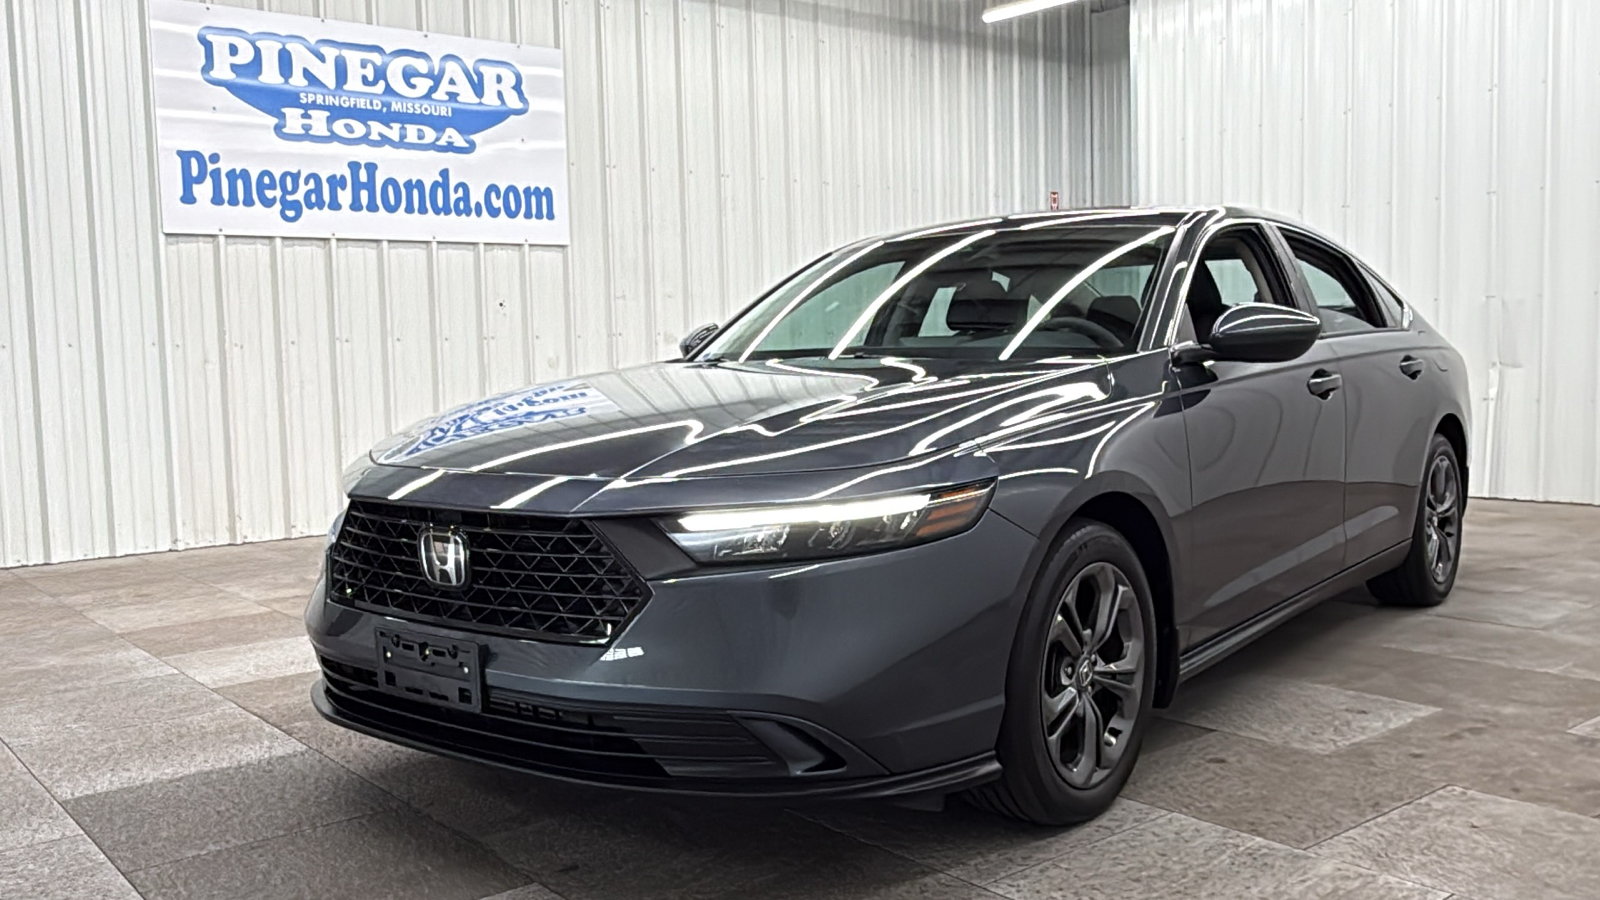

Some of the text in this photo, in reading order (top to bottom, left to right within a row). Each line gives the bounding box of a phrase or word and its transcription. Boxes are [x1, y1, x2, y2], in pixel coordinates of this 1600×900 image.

[206, 33, 525, 109] PINEGAR
[281, 107, 470, 148] HONDA
[299, 92, 453, 117] SPRINGFIELD, MISSOURI
[177, 150, 555, 222] PinegarHonda.com
